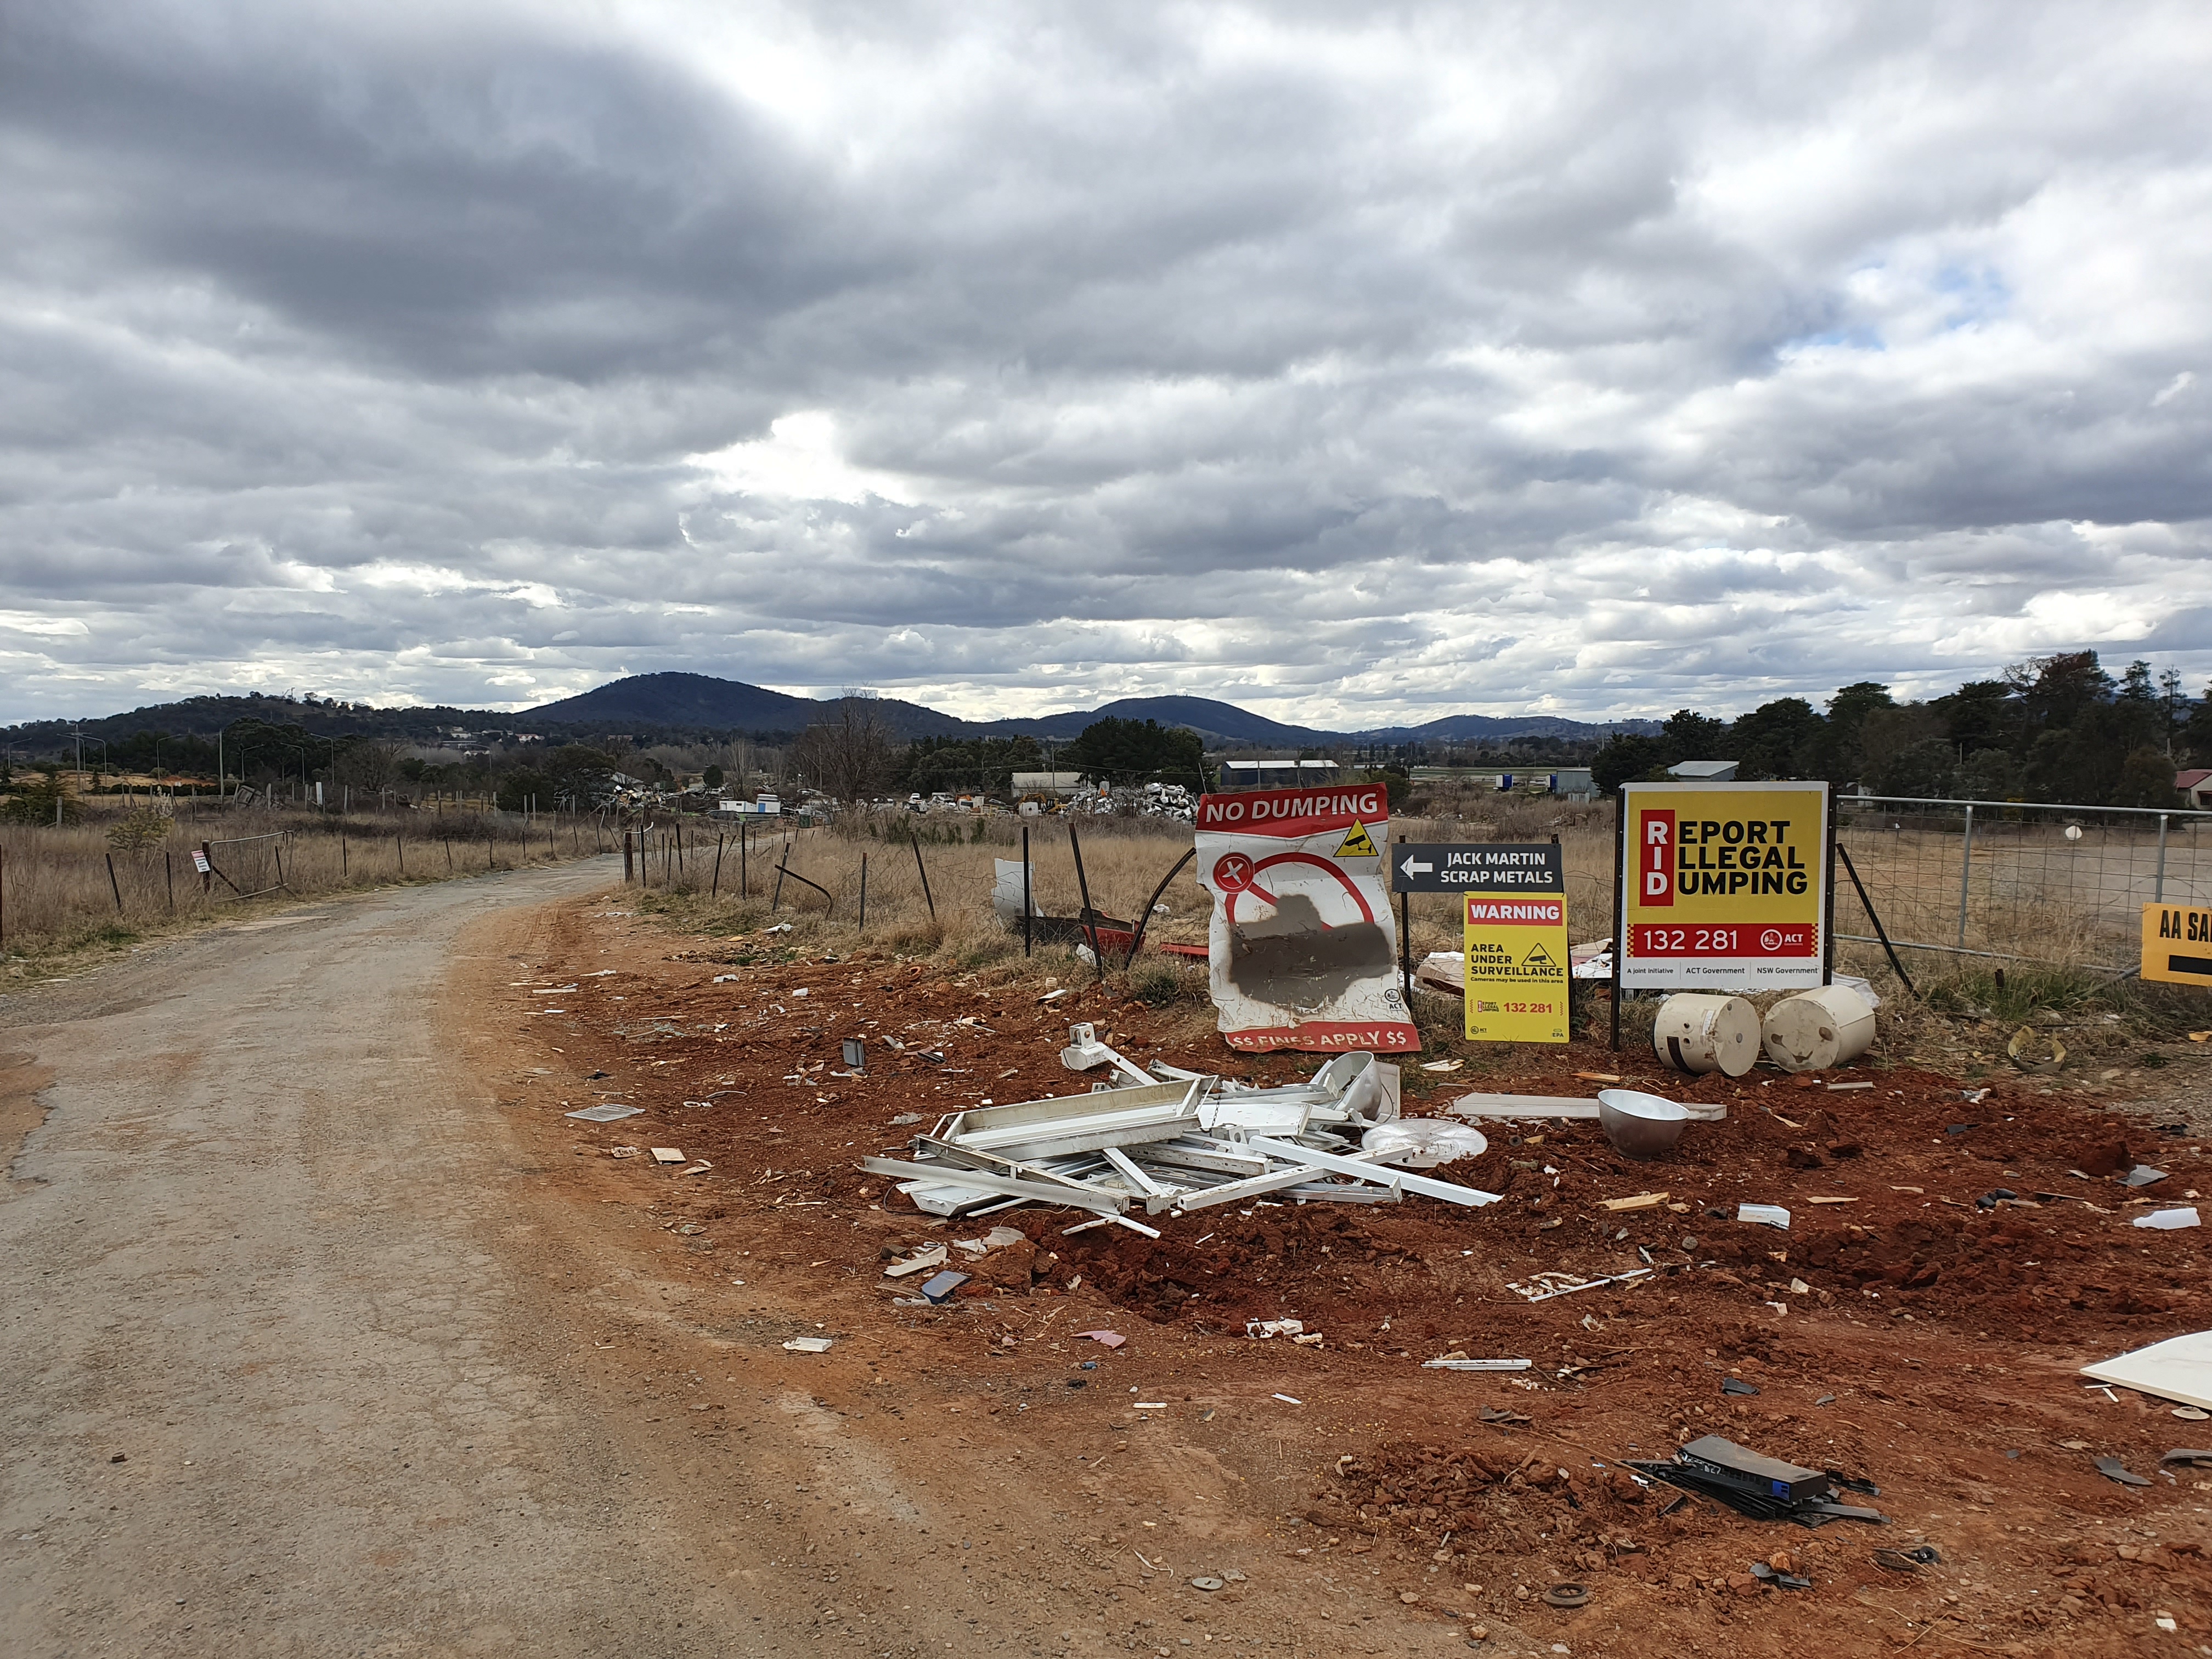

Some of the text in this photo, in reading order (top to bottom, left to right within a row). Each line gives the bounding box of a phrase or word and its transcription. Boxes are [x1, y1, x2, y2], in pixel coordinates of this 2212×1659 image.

[1206, 793, 1377, 822] NO DUMPING
[1447, 853, 1545, 867] JACK MARTIN
[1441, 871, 1553, 883] SCRAP METALS
[1471, 905, 1559, 919] WARNING
[2159, 910, 2181, 939] AA
[1644, 930, 1737, 950] 132 281
[1785, 934, 1804, 943] ACT
[1471, 944, 1504, 952] AREA
[1471, 955, 1512, 964] UNDER
[1471, 966, 1564, 976] SURVEILLANCE
[1503, 1002, 1552, 1013] 132 281
[1233, 1031, 1407, 1045] $$ FINES APPLY $$
